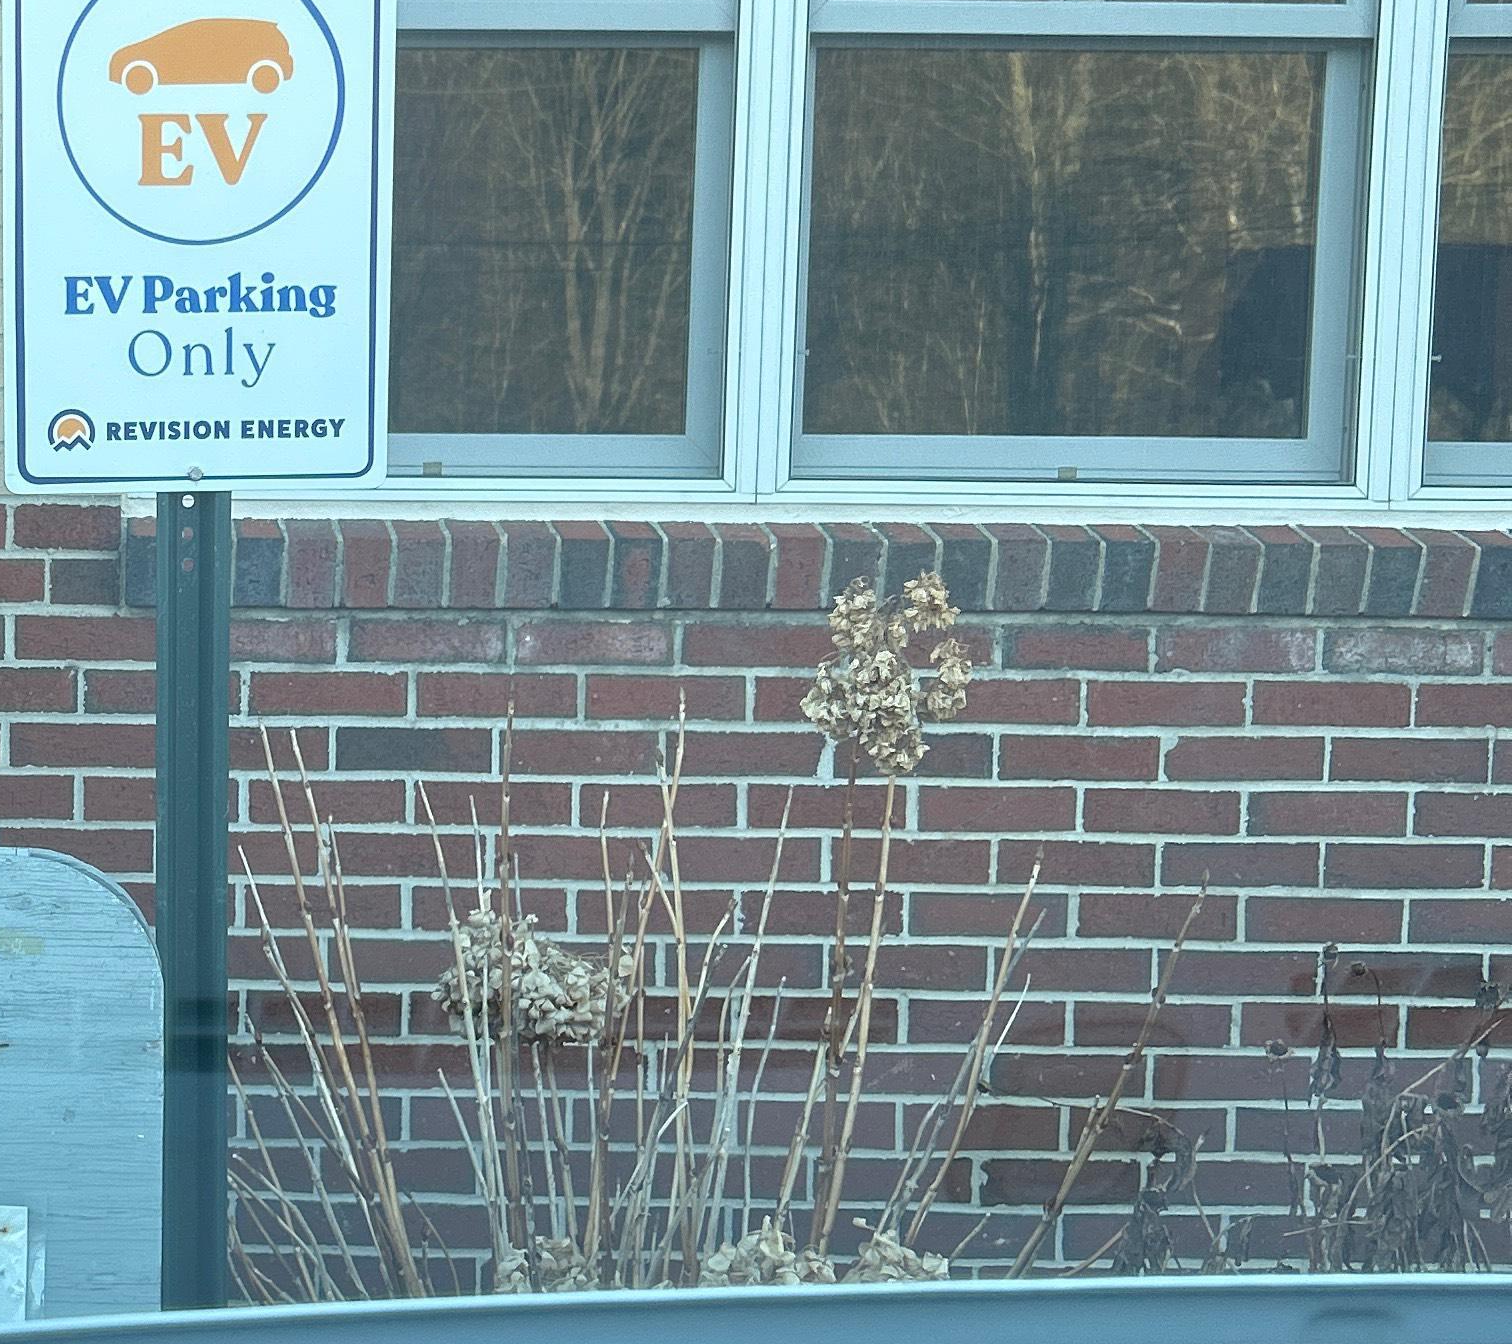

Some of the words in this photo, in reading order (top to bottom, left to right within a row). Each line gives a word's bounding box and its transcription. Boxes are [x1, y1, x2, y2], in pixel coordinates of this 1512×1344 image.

[137, 113, 268, 186] EV
[63, 275, 134, 316] EV
[142, 271, 338, 320] Parking
[128, 326, 276, 388] Only
[106, 418, 231, 441] REVISION
[240, 418, 346, 441] ENERGY
